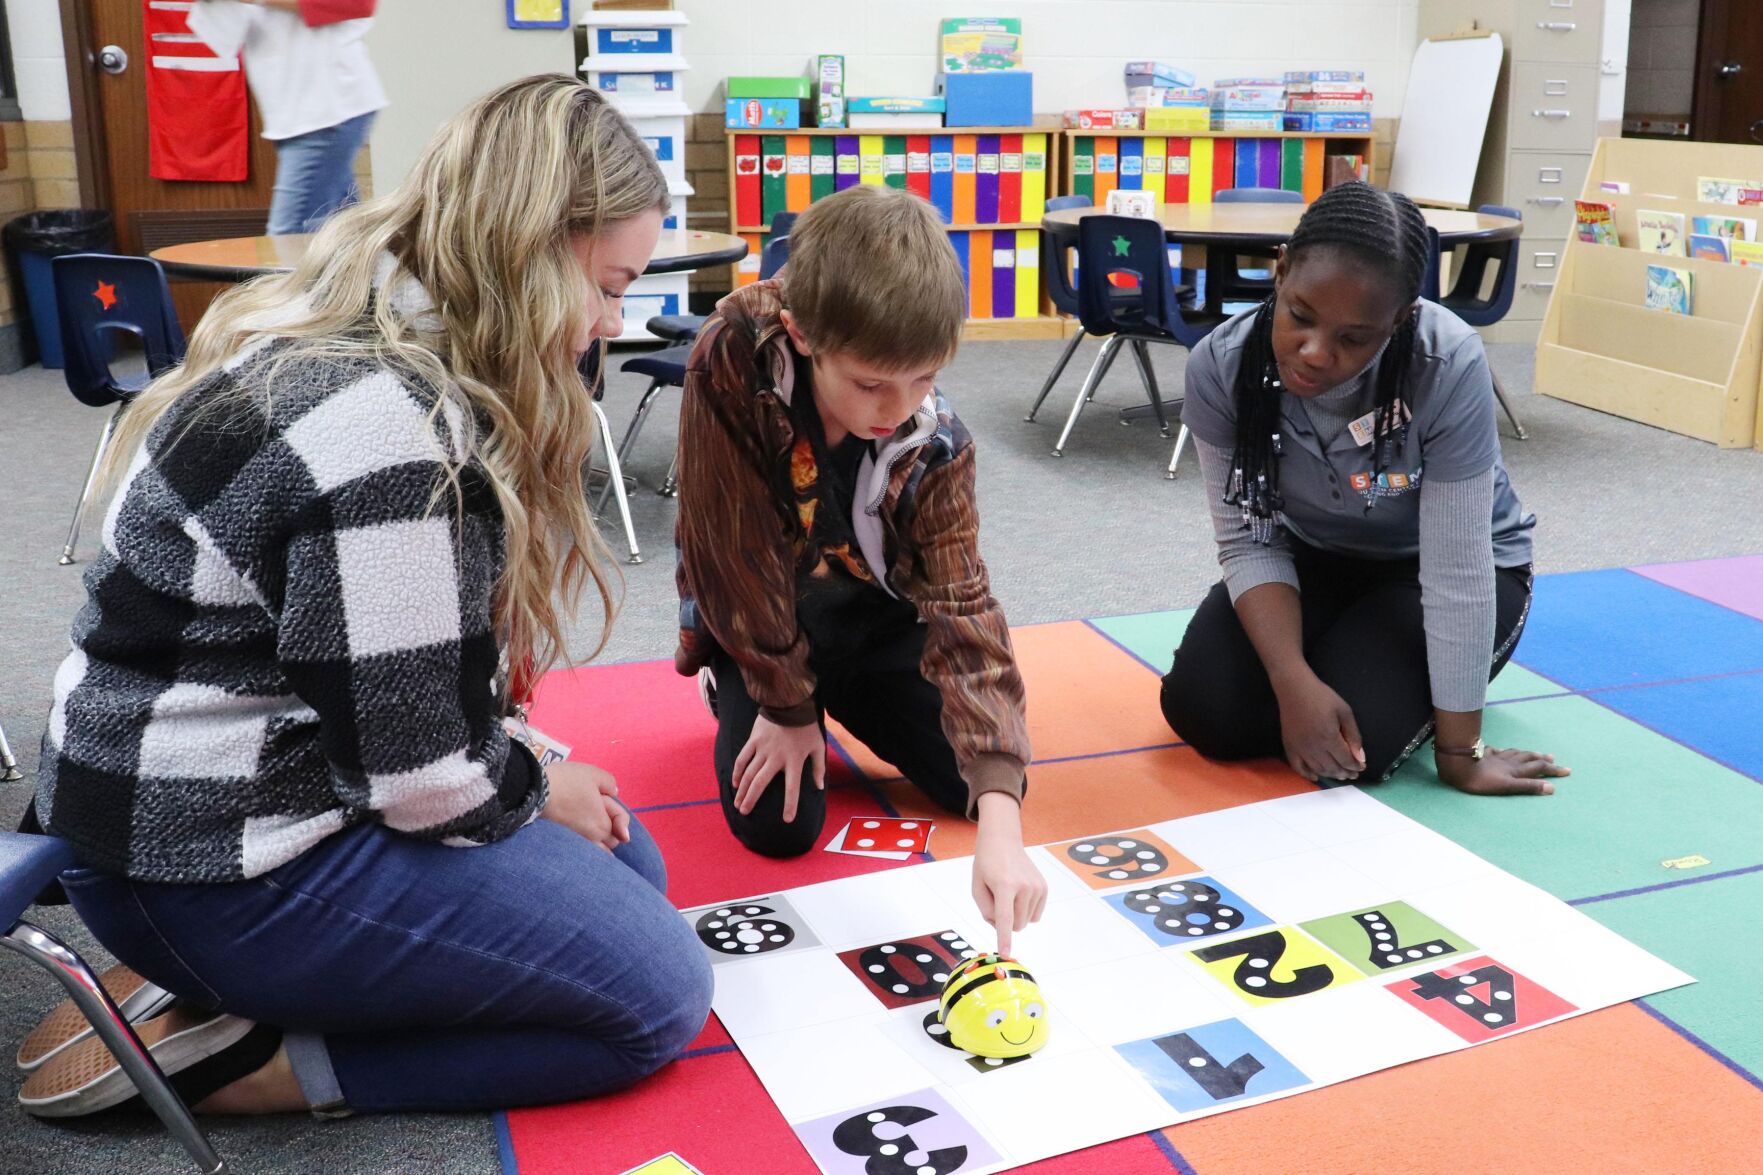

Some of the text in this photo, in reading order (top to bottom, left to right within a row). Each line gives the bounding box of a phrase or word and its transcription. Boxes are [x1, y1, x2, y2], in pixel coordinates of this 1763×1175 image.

[1123, 880, 1244, 937] 8
[1352, 910, 1458, 970] 7
[1190, 930, 1334, 999] 2
[1409, 963, 1518, 1031] 4
[1151, 1032, 1265, 1100] 1
[832, 1105, 968, 1175] 3
